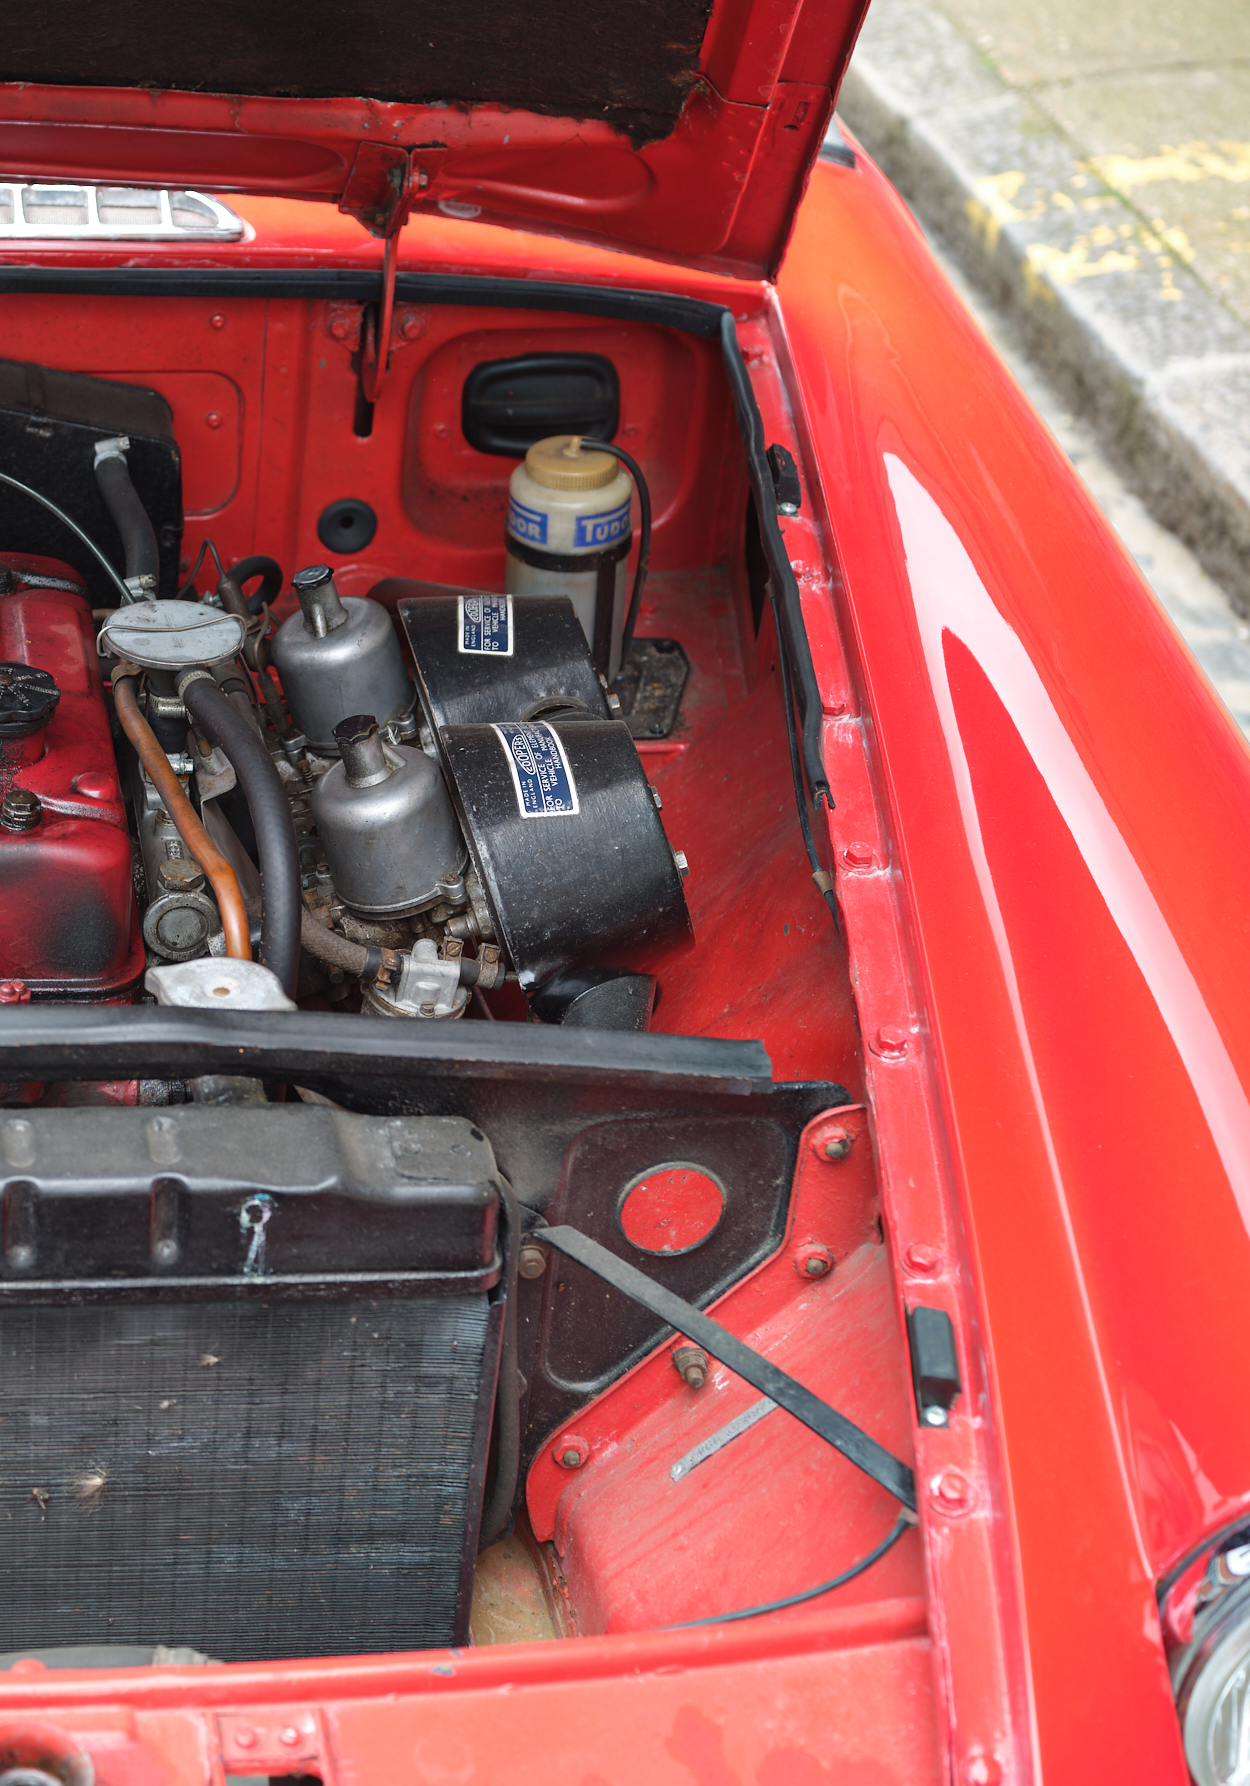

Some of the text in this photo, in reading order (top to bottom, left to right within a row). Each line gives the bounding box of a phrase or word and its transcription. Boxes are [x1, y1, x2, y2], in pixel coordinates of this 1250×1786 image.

[492, 641, 499, 651] TO
[515, 736, 533, 772] COOPERS
[534, 751, 543, 761] OF
[545, 736, 562, 769] HANDBOOK
[538, 763, 552, 792] SERVICE
[545, 758, 558, 787] VEHICLE
[523, 789, 531, 807] MADE
[527, 778, 538, 809] ENGLAND
[546, 795, 555, 811] FOR
[554, 798, 563, 811] TO
